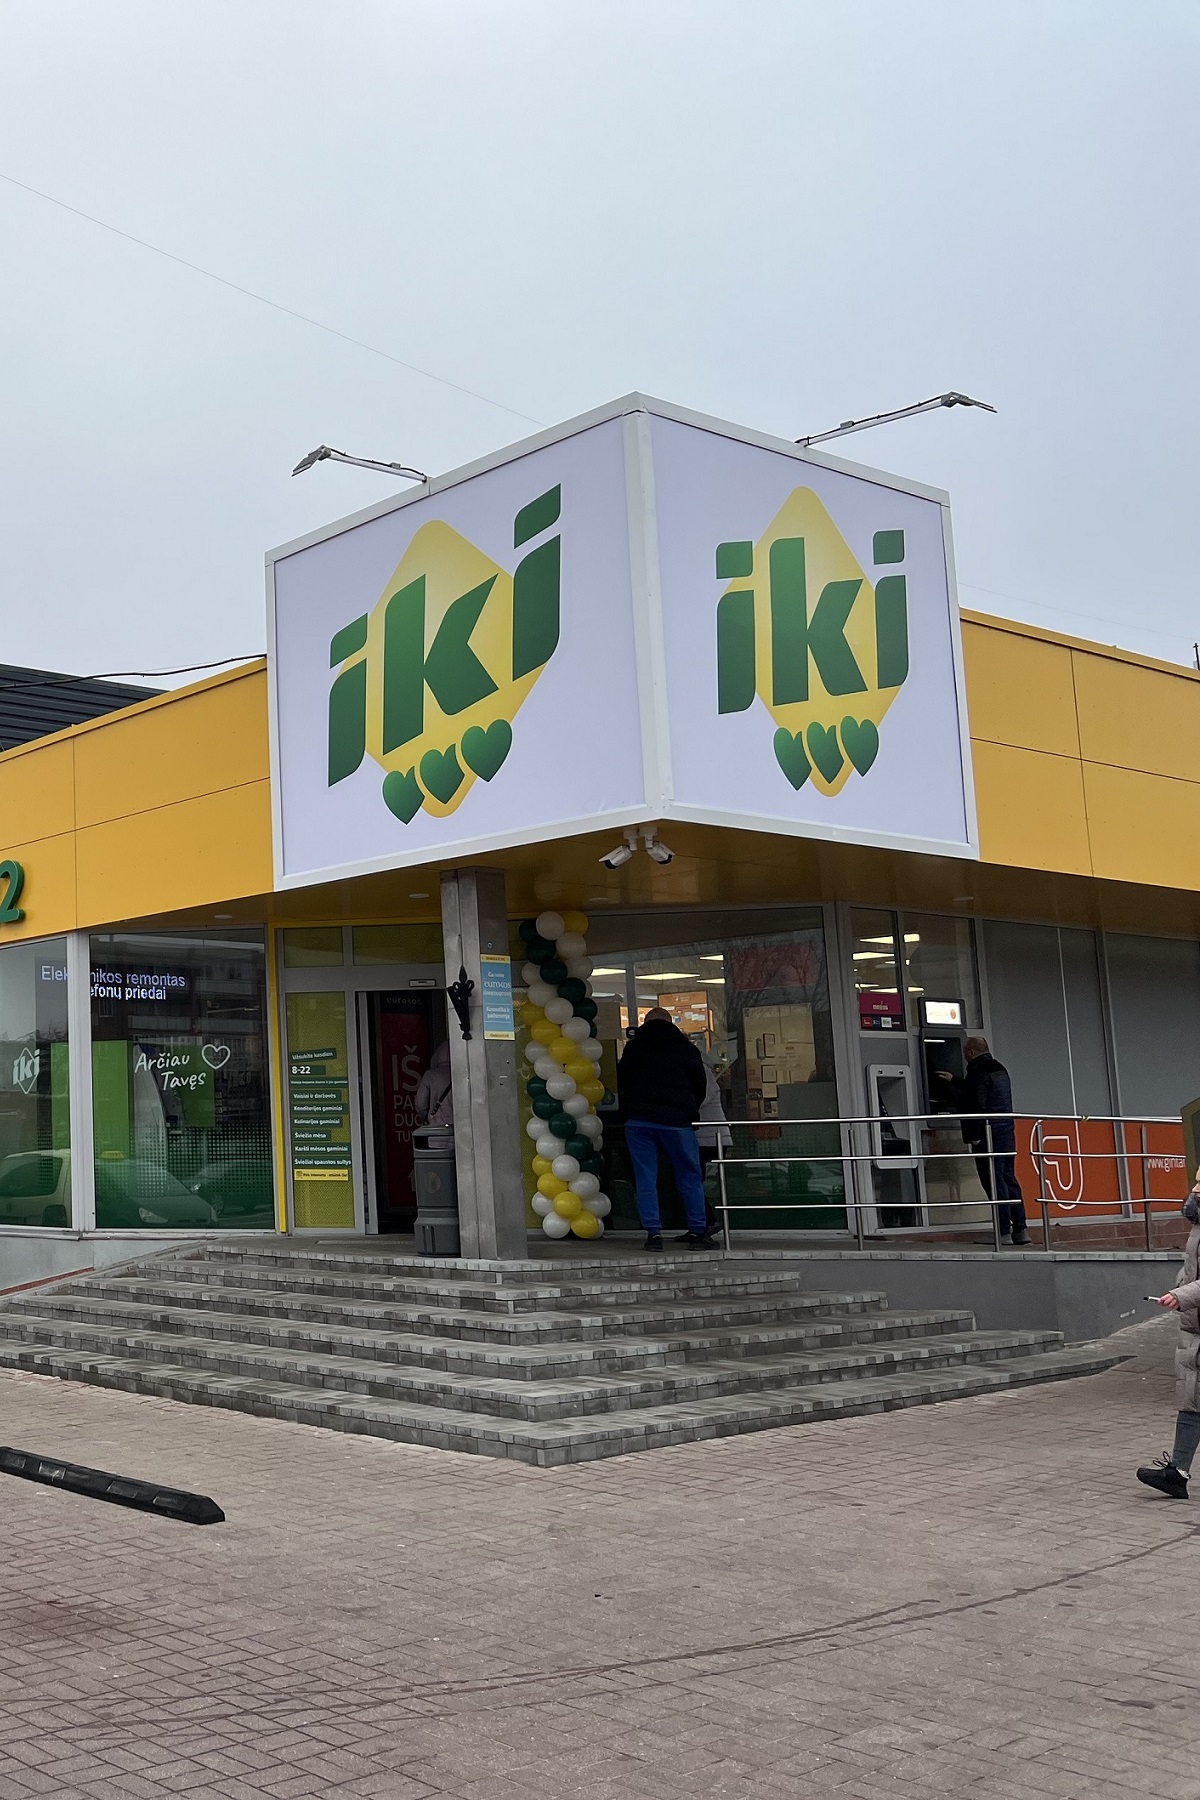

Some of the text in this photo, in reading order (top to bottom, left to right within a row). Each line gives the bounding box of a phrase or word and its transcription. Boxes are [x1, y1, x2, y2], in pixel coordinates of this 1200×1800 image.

[715, 529, 909, 715] iki
[328, 483, 561, 788] iki
[126, 973, 186, 987] remontas
[125, 986, 167, 1000] priedai
[12, 1048, 40, 1085] iki
[134, 1053, 191, 1073] Arčiau
[291, 1065, 311, 1074] 8-22
[391, 1044, 422, 1092] IŠ
[161, 1071, 207, 1091] Tavęs
